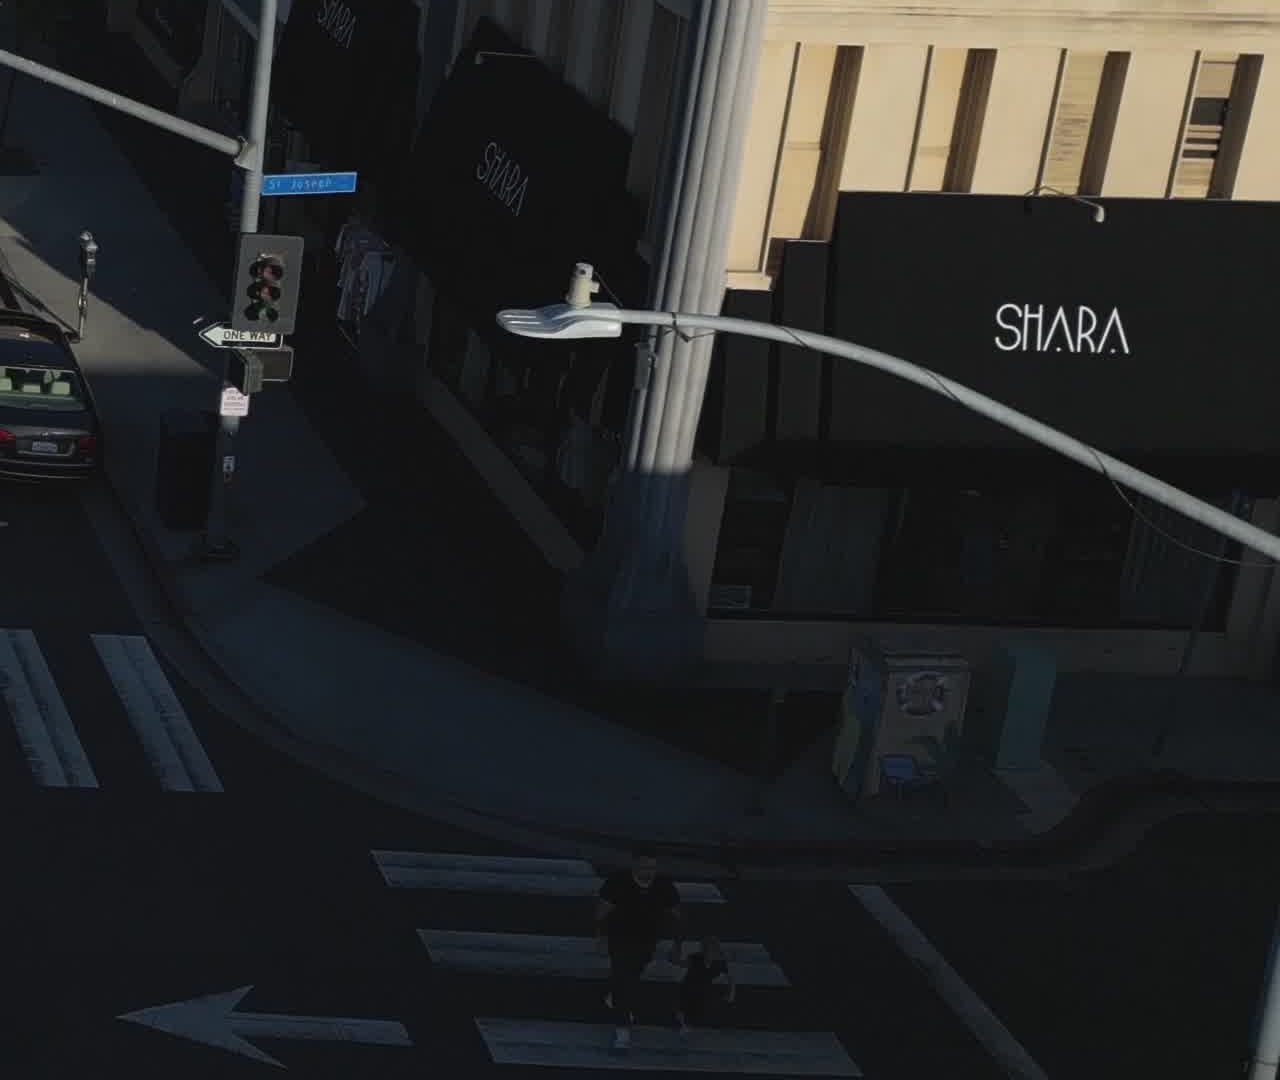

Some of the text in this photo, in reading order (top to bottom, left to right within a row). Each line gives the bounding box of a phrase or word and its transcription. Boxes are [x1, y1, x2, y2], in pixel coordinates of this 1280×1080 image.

[477, 140, 530, 217] SHARA
[224, 329, 273, 342] ONE WAY
[993, 301, 1131, 356] SHARA
